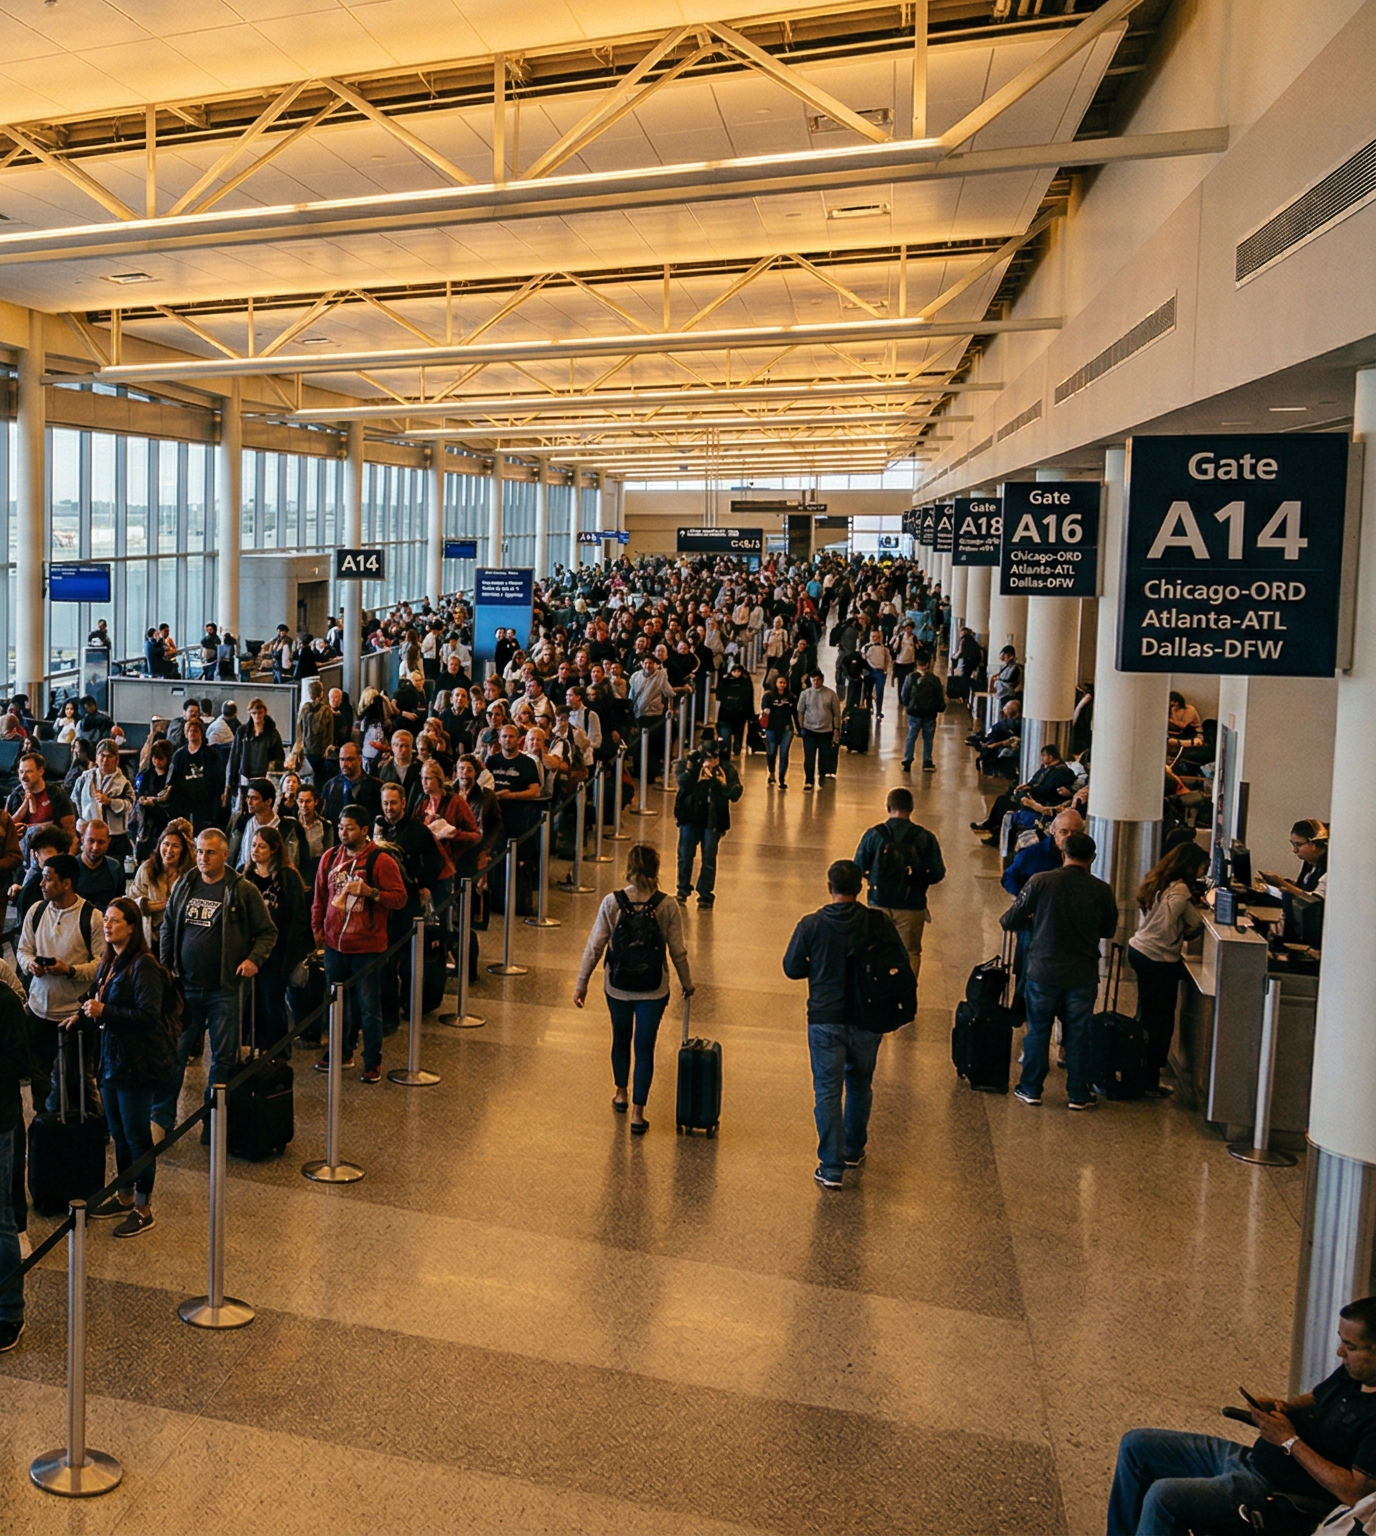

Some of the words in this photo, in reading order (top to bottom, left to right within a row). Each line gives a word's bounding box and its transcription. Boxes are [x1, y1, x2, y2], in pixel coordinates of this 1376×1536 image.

[1188, 452, 1279, 481] Gate
[969, 502, 996, 512] Gate
[1029, 490, 1071, 505] Gate
[959, 516, 1003, 535] A18
[1011, 513, 1083, 544] A16
[1146, 501, 1308, 560] A14
[341, 554, 380, 572] A14
[1009, 563, 1076, 575] Atlanta-ATL
[1009, 577, 1075, 588] Dallas-DFW
[1143, 579, 1307, 604] Chicago-ORD
[1141, 608, 1287, 630] Atlanta-ATL
[1141, 637, 1284, 659] Dallas-DFW
